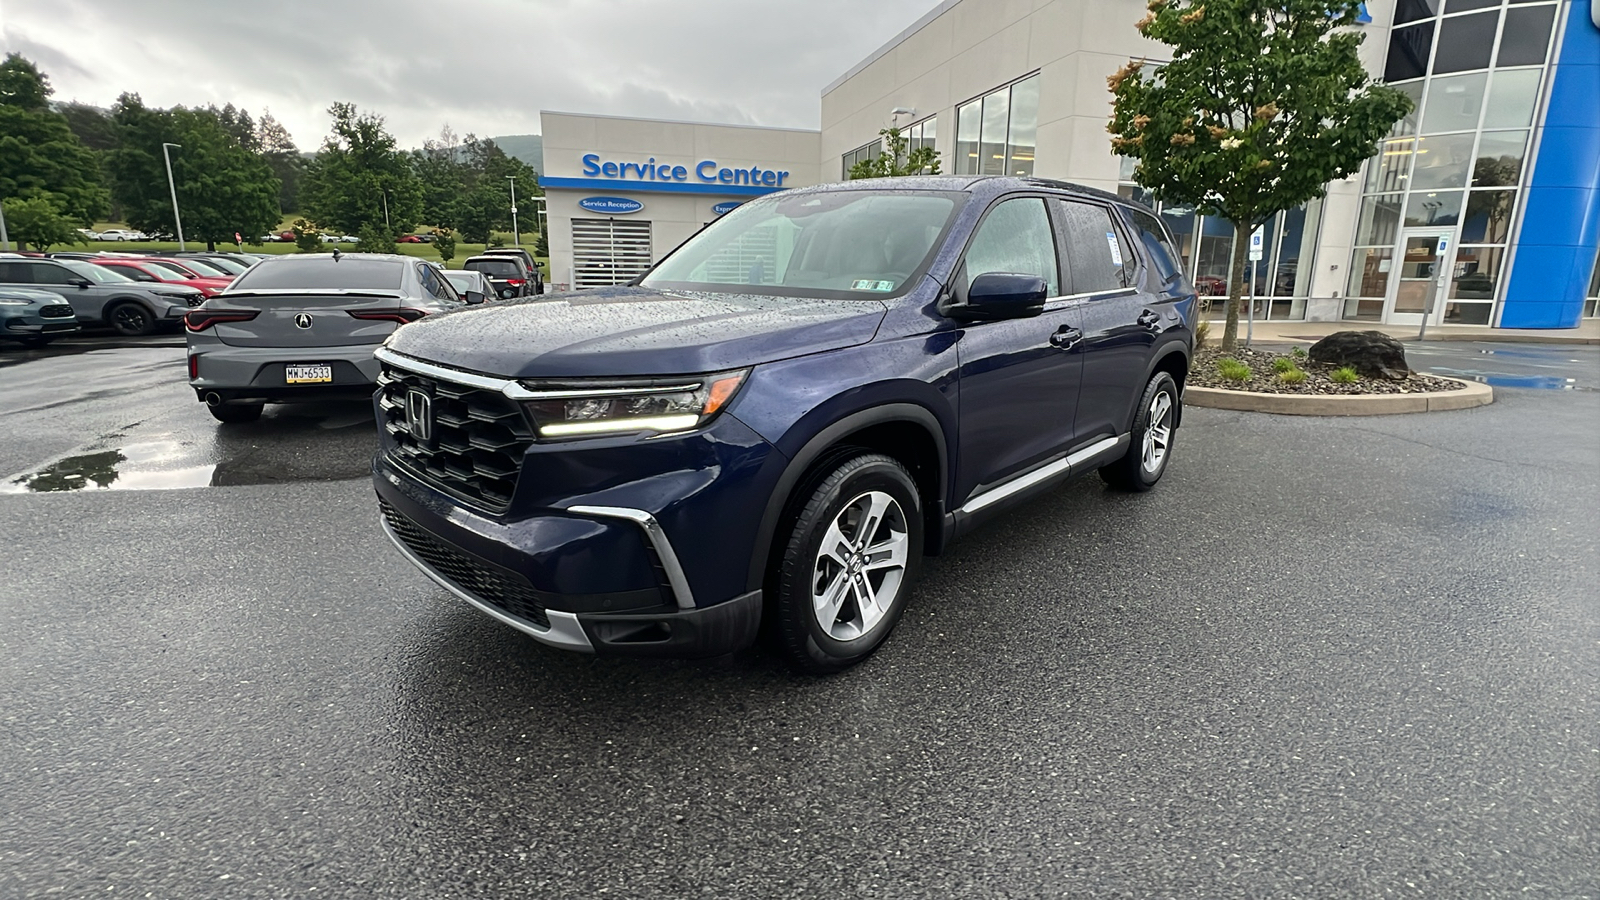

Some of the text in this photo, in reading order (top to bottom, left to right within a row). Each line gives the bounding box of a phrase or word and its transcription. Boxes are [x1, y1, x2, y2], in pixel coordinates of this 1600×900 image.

[582, 154, 789, 187] Service Center
[607, 201, 640, 209] Reception
[715, 205, 733, 213] Expr
